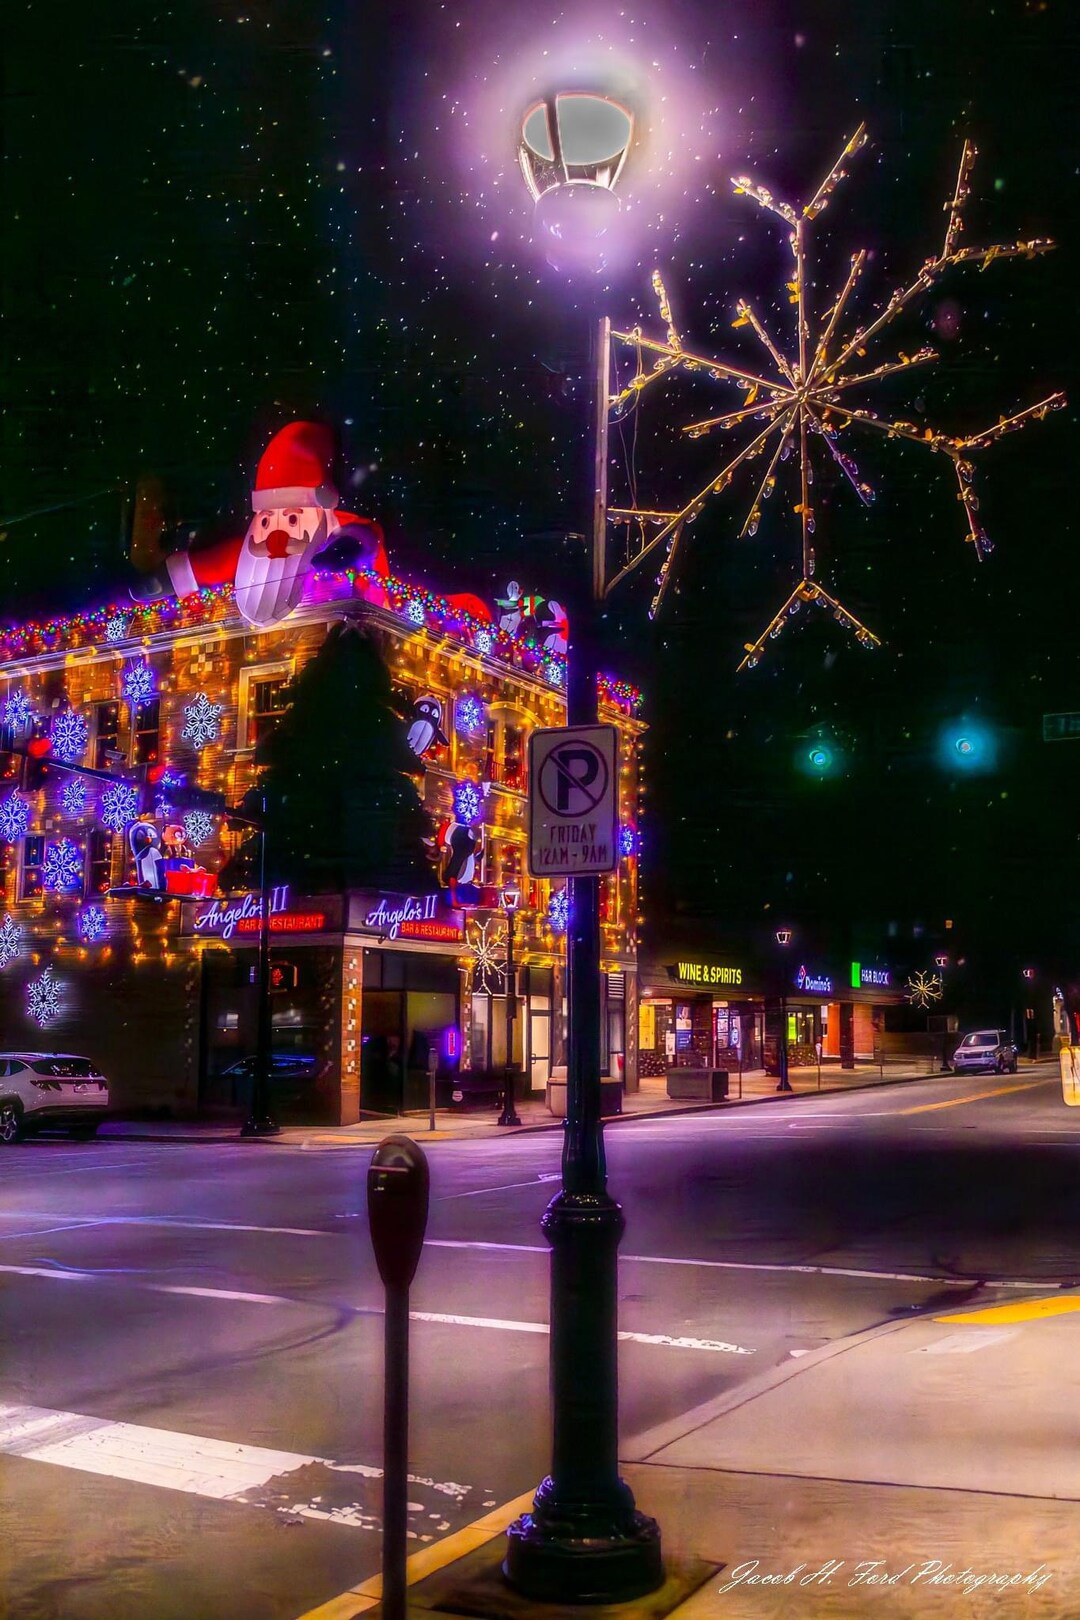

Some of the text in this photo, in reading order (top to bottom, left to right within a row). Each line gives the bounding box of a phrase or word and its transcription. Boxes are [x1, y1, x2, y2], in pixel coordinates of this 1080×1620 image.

[550, 824, 597, 843] FRIDAY
[539, 847, 568, 865] 12AM
[582, 845, 607, 863] 9AM
[365, 897, 422, 940] Angelo's
[401, 922, 414, 933] BAR
[421, 925, 458, 938] RESTAURANT
[678, 962, 742, 984] WINE & SPIRITS
[861, 969, 889, 985] H&R BLOCK
[805, 976, 831, 991] Domino's
